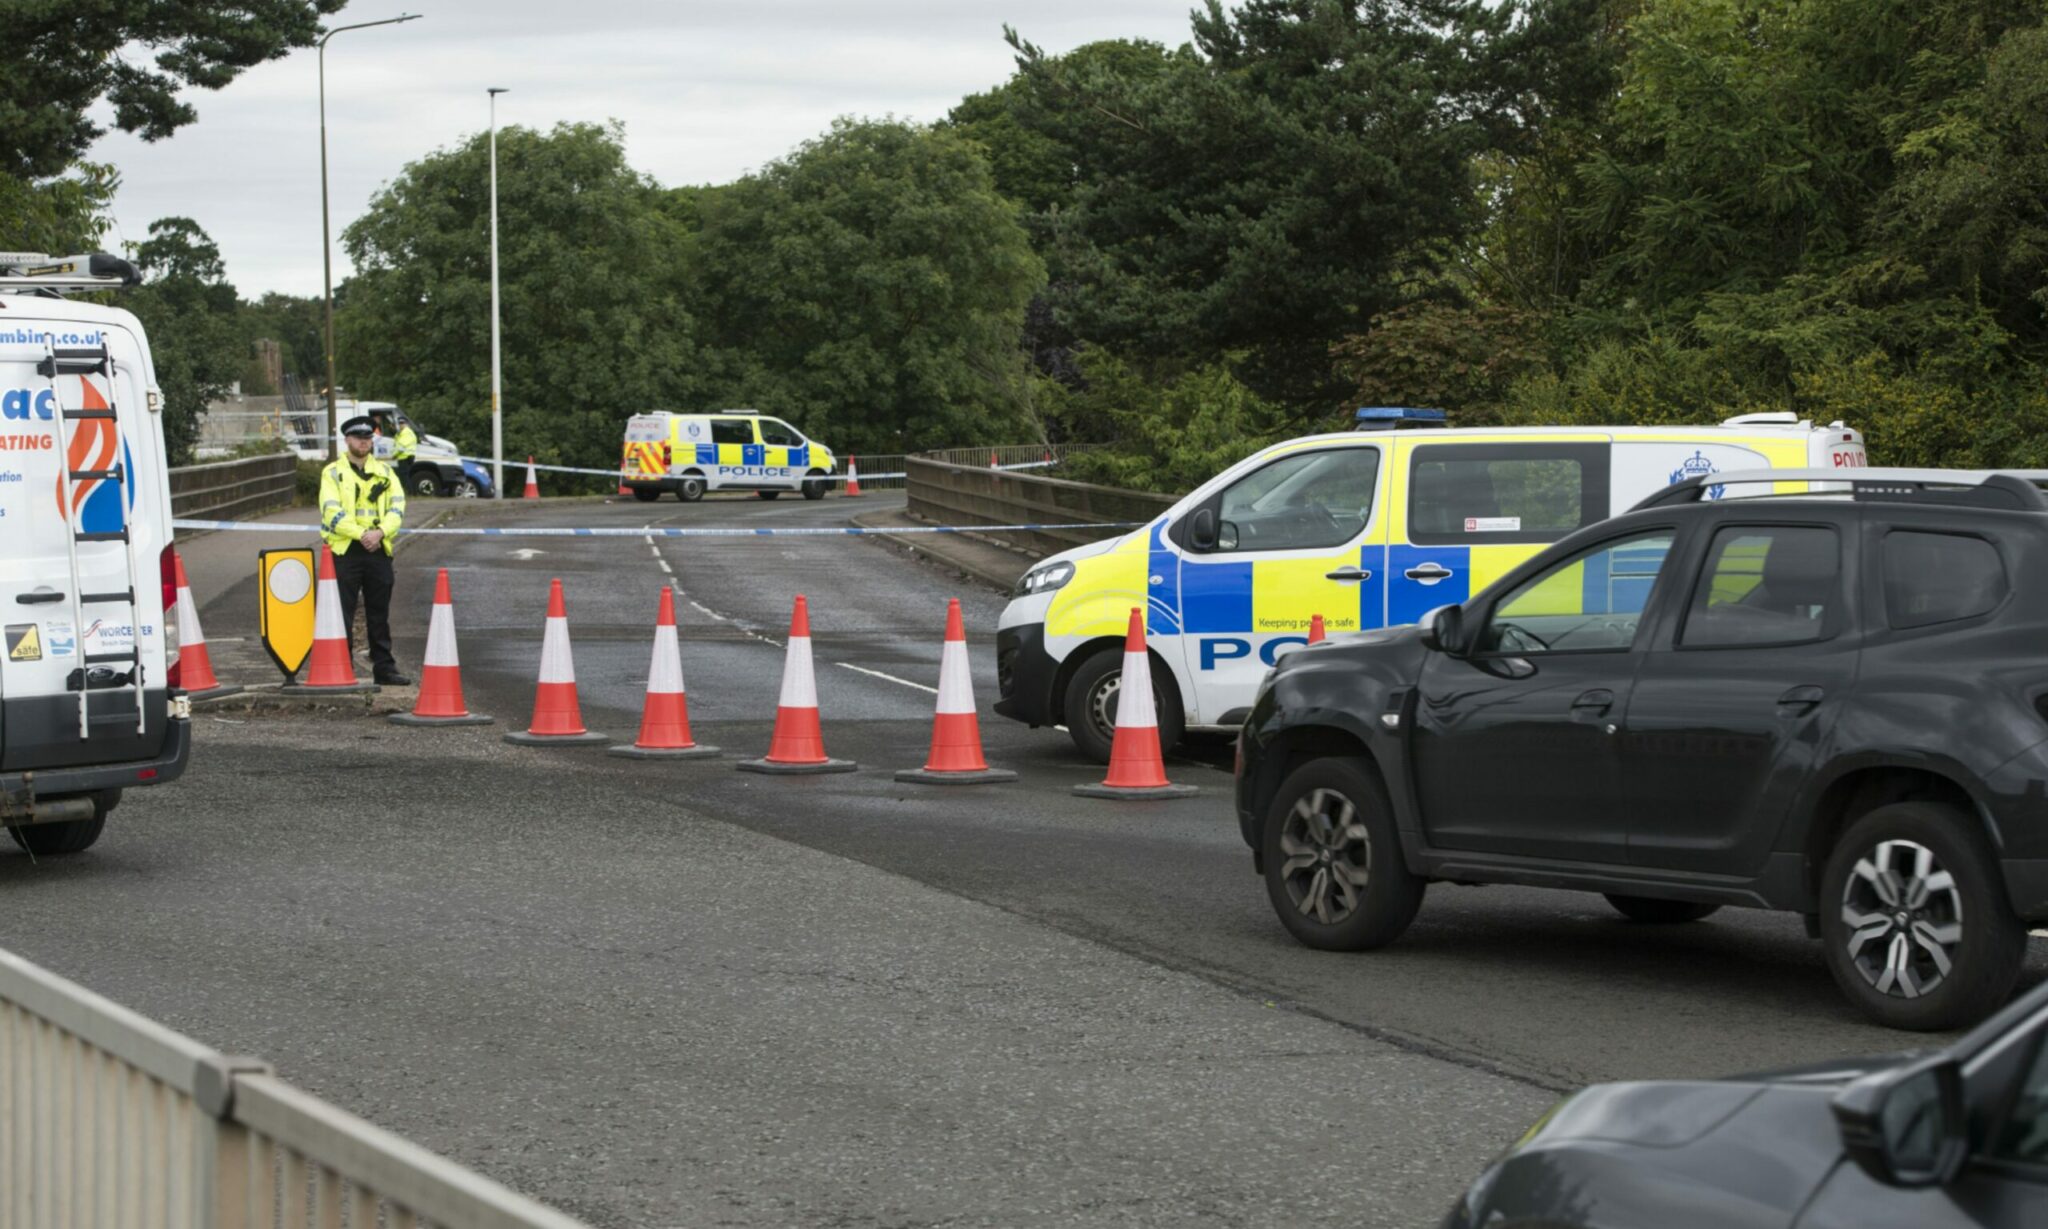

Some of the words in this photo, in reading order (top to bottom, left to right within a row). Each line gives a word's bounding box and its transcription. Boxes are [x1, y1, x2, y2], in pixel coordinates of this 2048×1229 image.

[0, 329, 103, 345] mbin.co.uk
[718, 466, 792, 477] POLICE
[1258, 618, 1298, 629] Keeping
[1299, 618, 1333, 628] pele
[1335, 617, 1355, 627] safe
[98, 625, 153, 637] WORCETER
